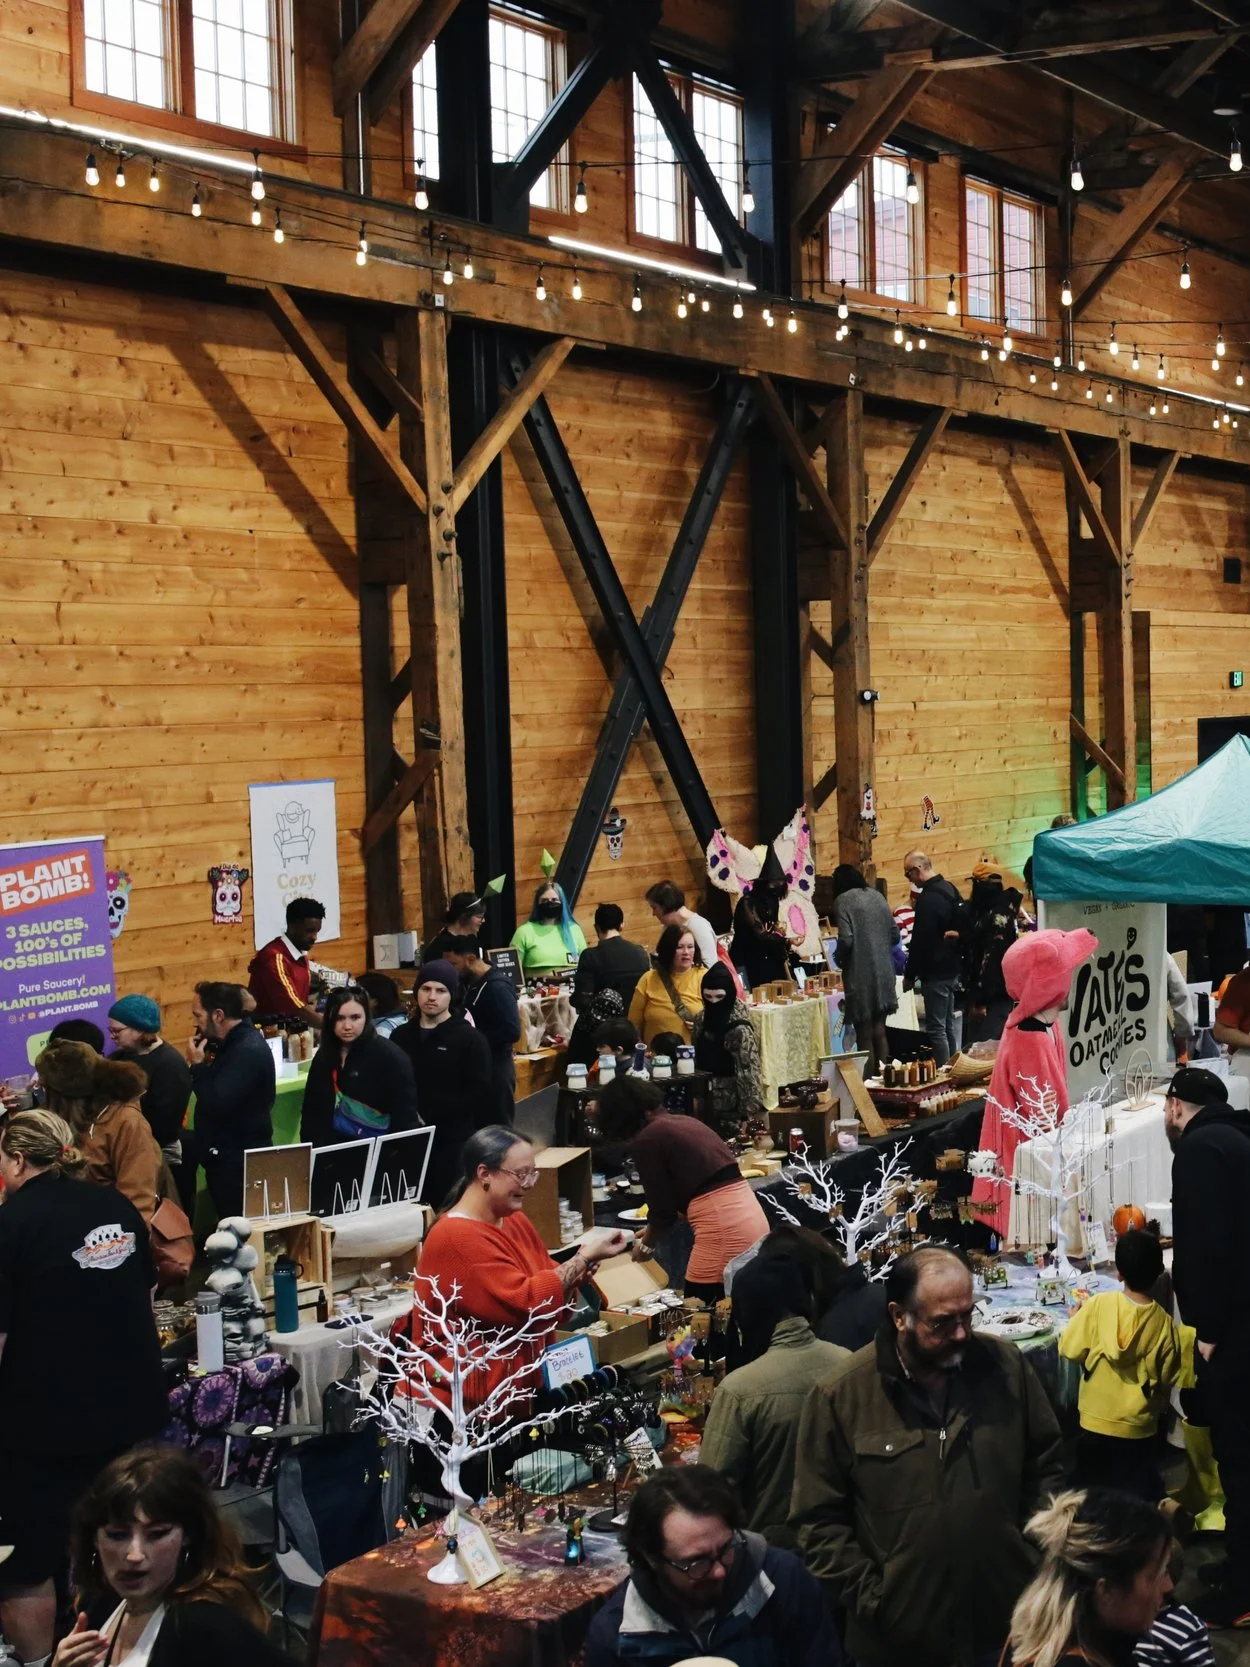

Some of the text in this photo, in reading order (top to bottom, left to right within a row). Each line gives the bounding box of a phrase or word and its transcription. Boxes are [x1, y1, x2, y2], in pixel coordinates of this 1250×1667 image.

[0, 854, 86, 892] PLANT
[277, 871, 317, 890] Cozy
[1, 872, 90, 910] BOMB!
[6, 917, 89, 939] 3 SAUCES,
[14, 932, 83, 954] 100's OF
[0, 944, 107, 971] OSSIBILITIES
[18, 974, 86, 994] Pure Saucery!
[38, 1000, 99, 1018] @PLANT.BOMB
